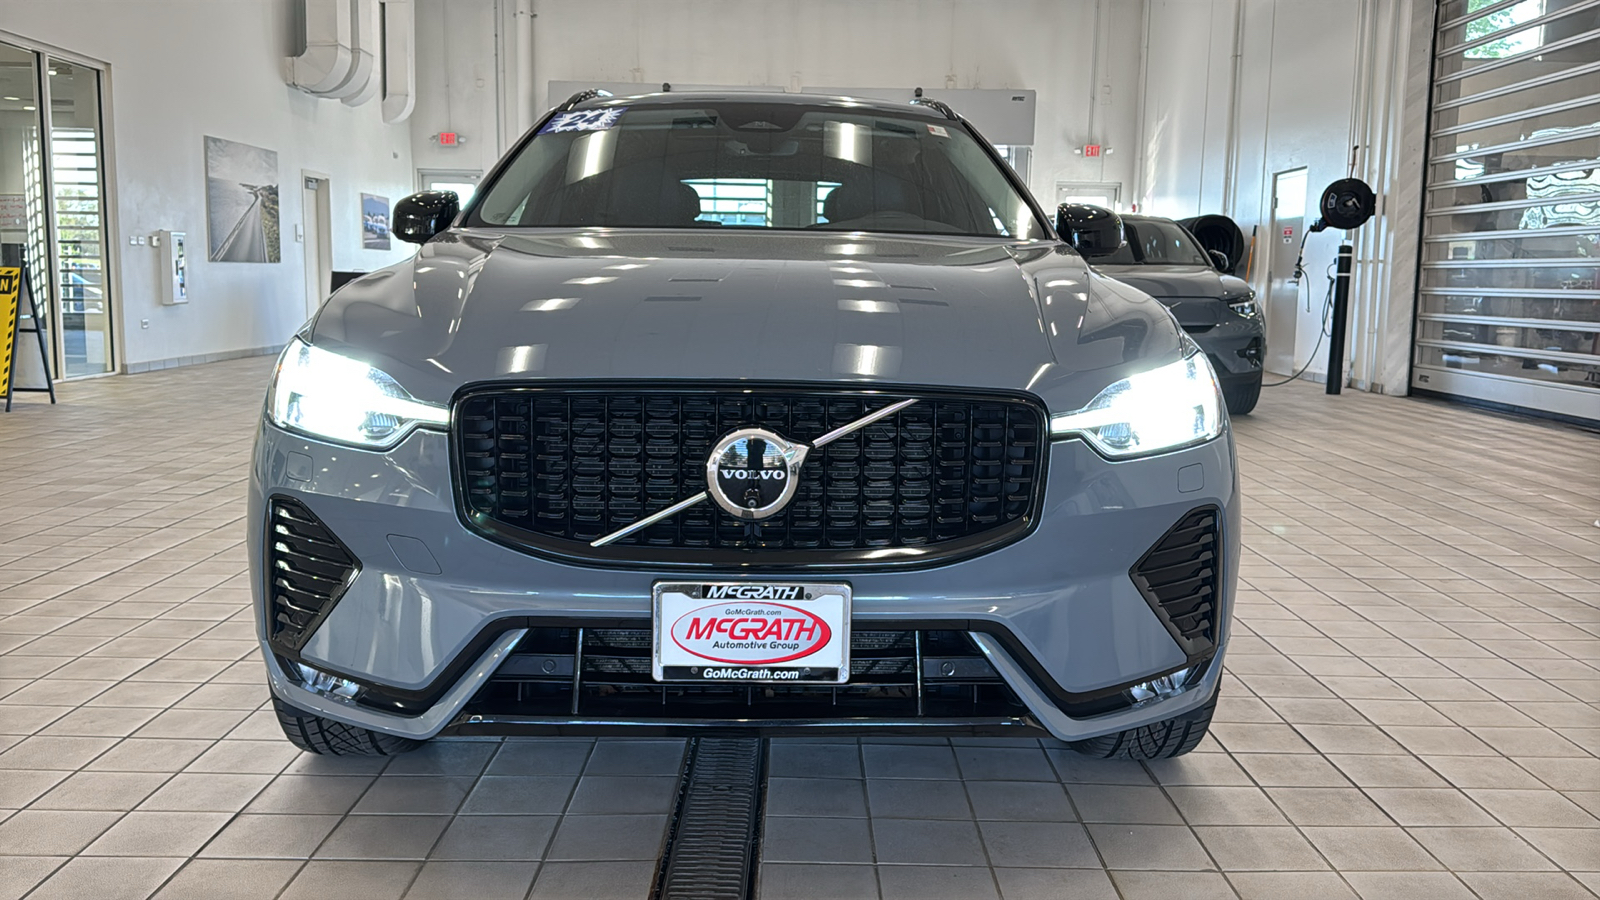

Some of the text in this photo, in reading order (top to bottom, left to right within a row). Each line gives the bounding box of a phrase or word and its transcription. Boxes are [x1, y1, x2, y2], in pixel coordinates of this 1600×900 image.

[560, 112, 605, 127] 24
[1085, 145, 1100, 157] EXIT
[720, 469, 785, 480] VOLVO
[712, 641, 800, 651] Automotive Group
[703, 668, 799, 680] GoMcGrath.com
